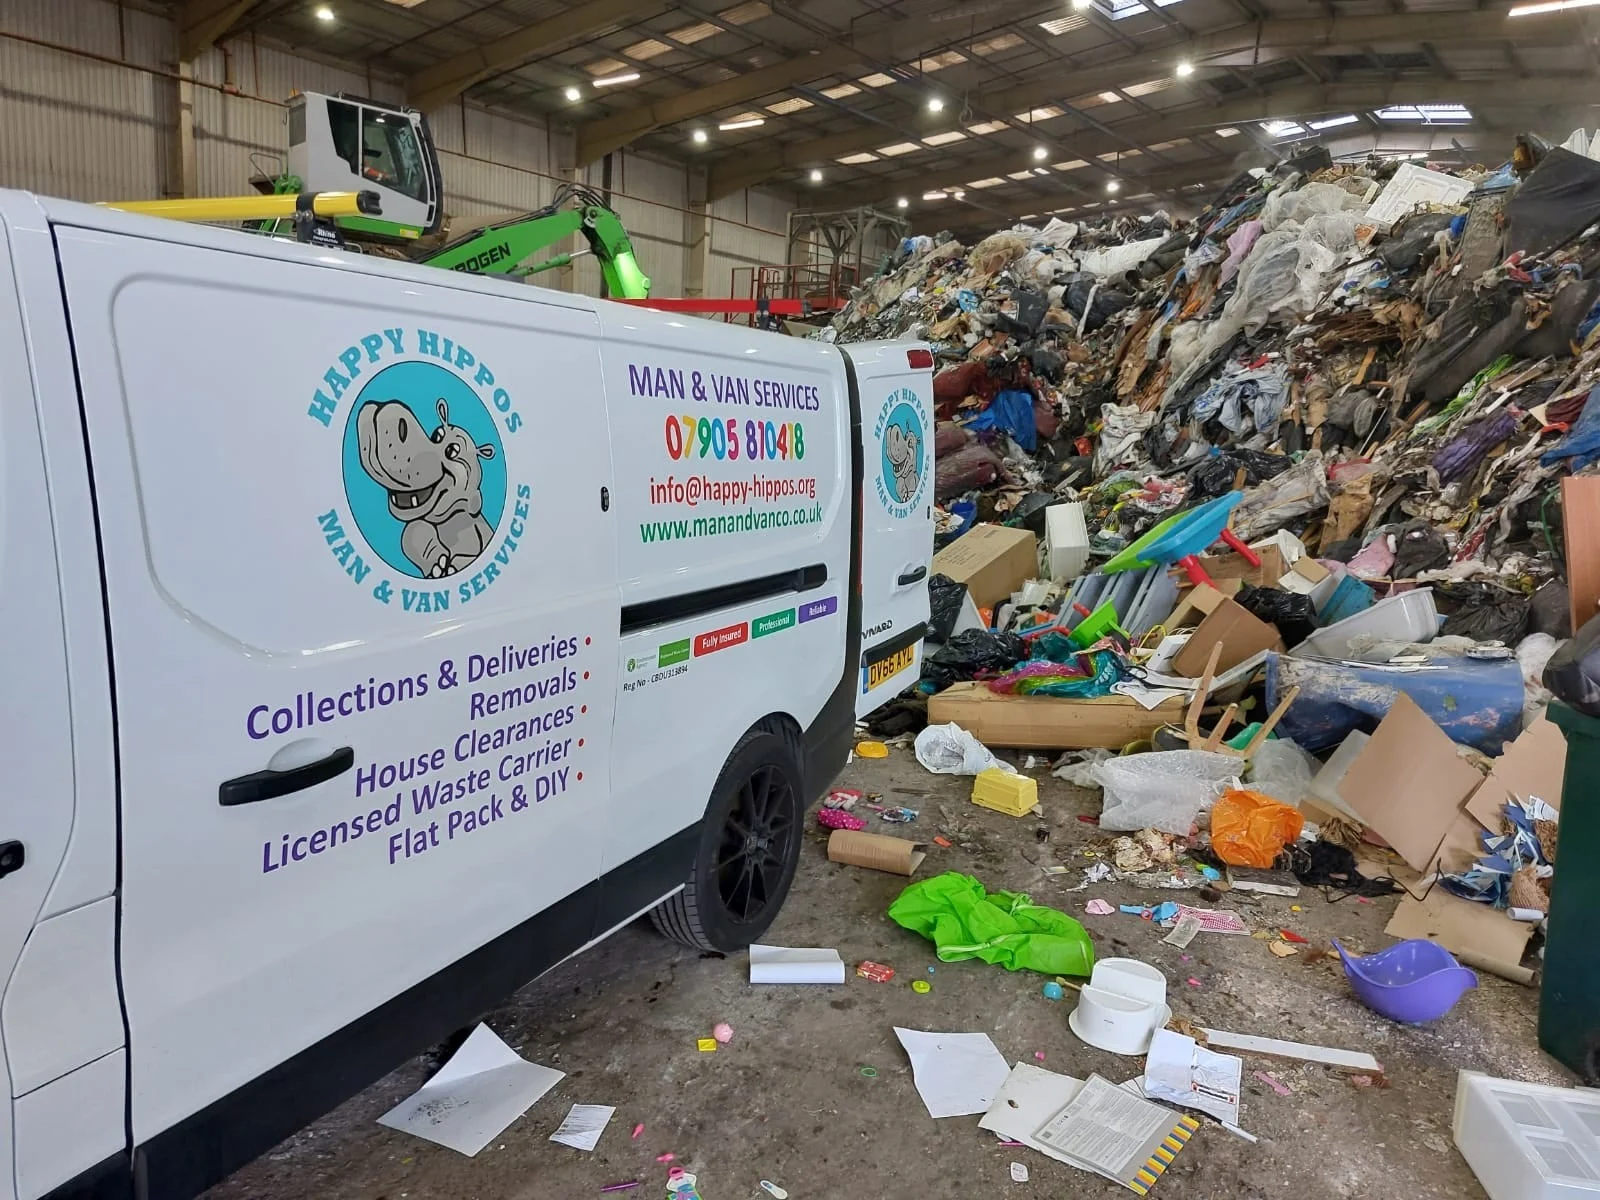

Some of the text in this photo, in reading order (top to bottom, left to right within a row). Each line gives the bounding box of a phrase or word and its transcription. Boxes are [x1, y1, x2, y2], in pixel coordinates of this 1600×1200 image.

[307, 327, 523, 434] HAPPY HIPPOS
[629, 364, 820, 412] MAN & VAN SERVICES
[665, 414, 805, 461] 07905 810418
[874, 387, 929, 441] HAPPY HIPPOS
[650, 473, 816, 507] info@happy-hippos.org
[640, 501, 823, 543] www.manandvanco.co.uk
[317, 484, 531, 612] MAN & VAN SERVICES
[759, 613, 790, 632] Professional
[808, 603, 827, 616] Reliable
[702, 627, 742, 649] Fully Insured
[246, 635, 578, 740] Collections & Deliveries
[470, 666, 577, 720] Removals
[623, 682, 636, 692] Reg
[636, 679, 646, 688] No
[870, 656, 895, 686] DV66
[355, 704, 575, 797] House Clearances
[262, 736, 572, 874] Licensed Waste Carrier
[388, 766, 569, 865] Flat Pack & DIY
